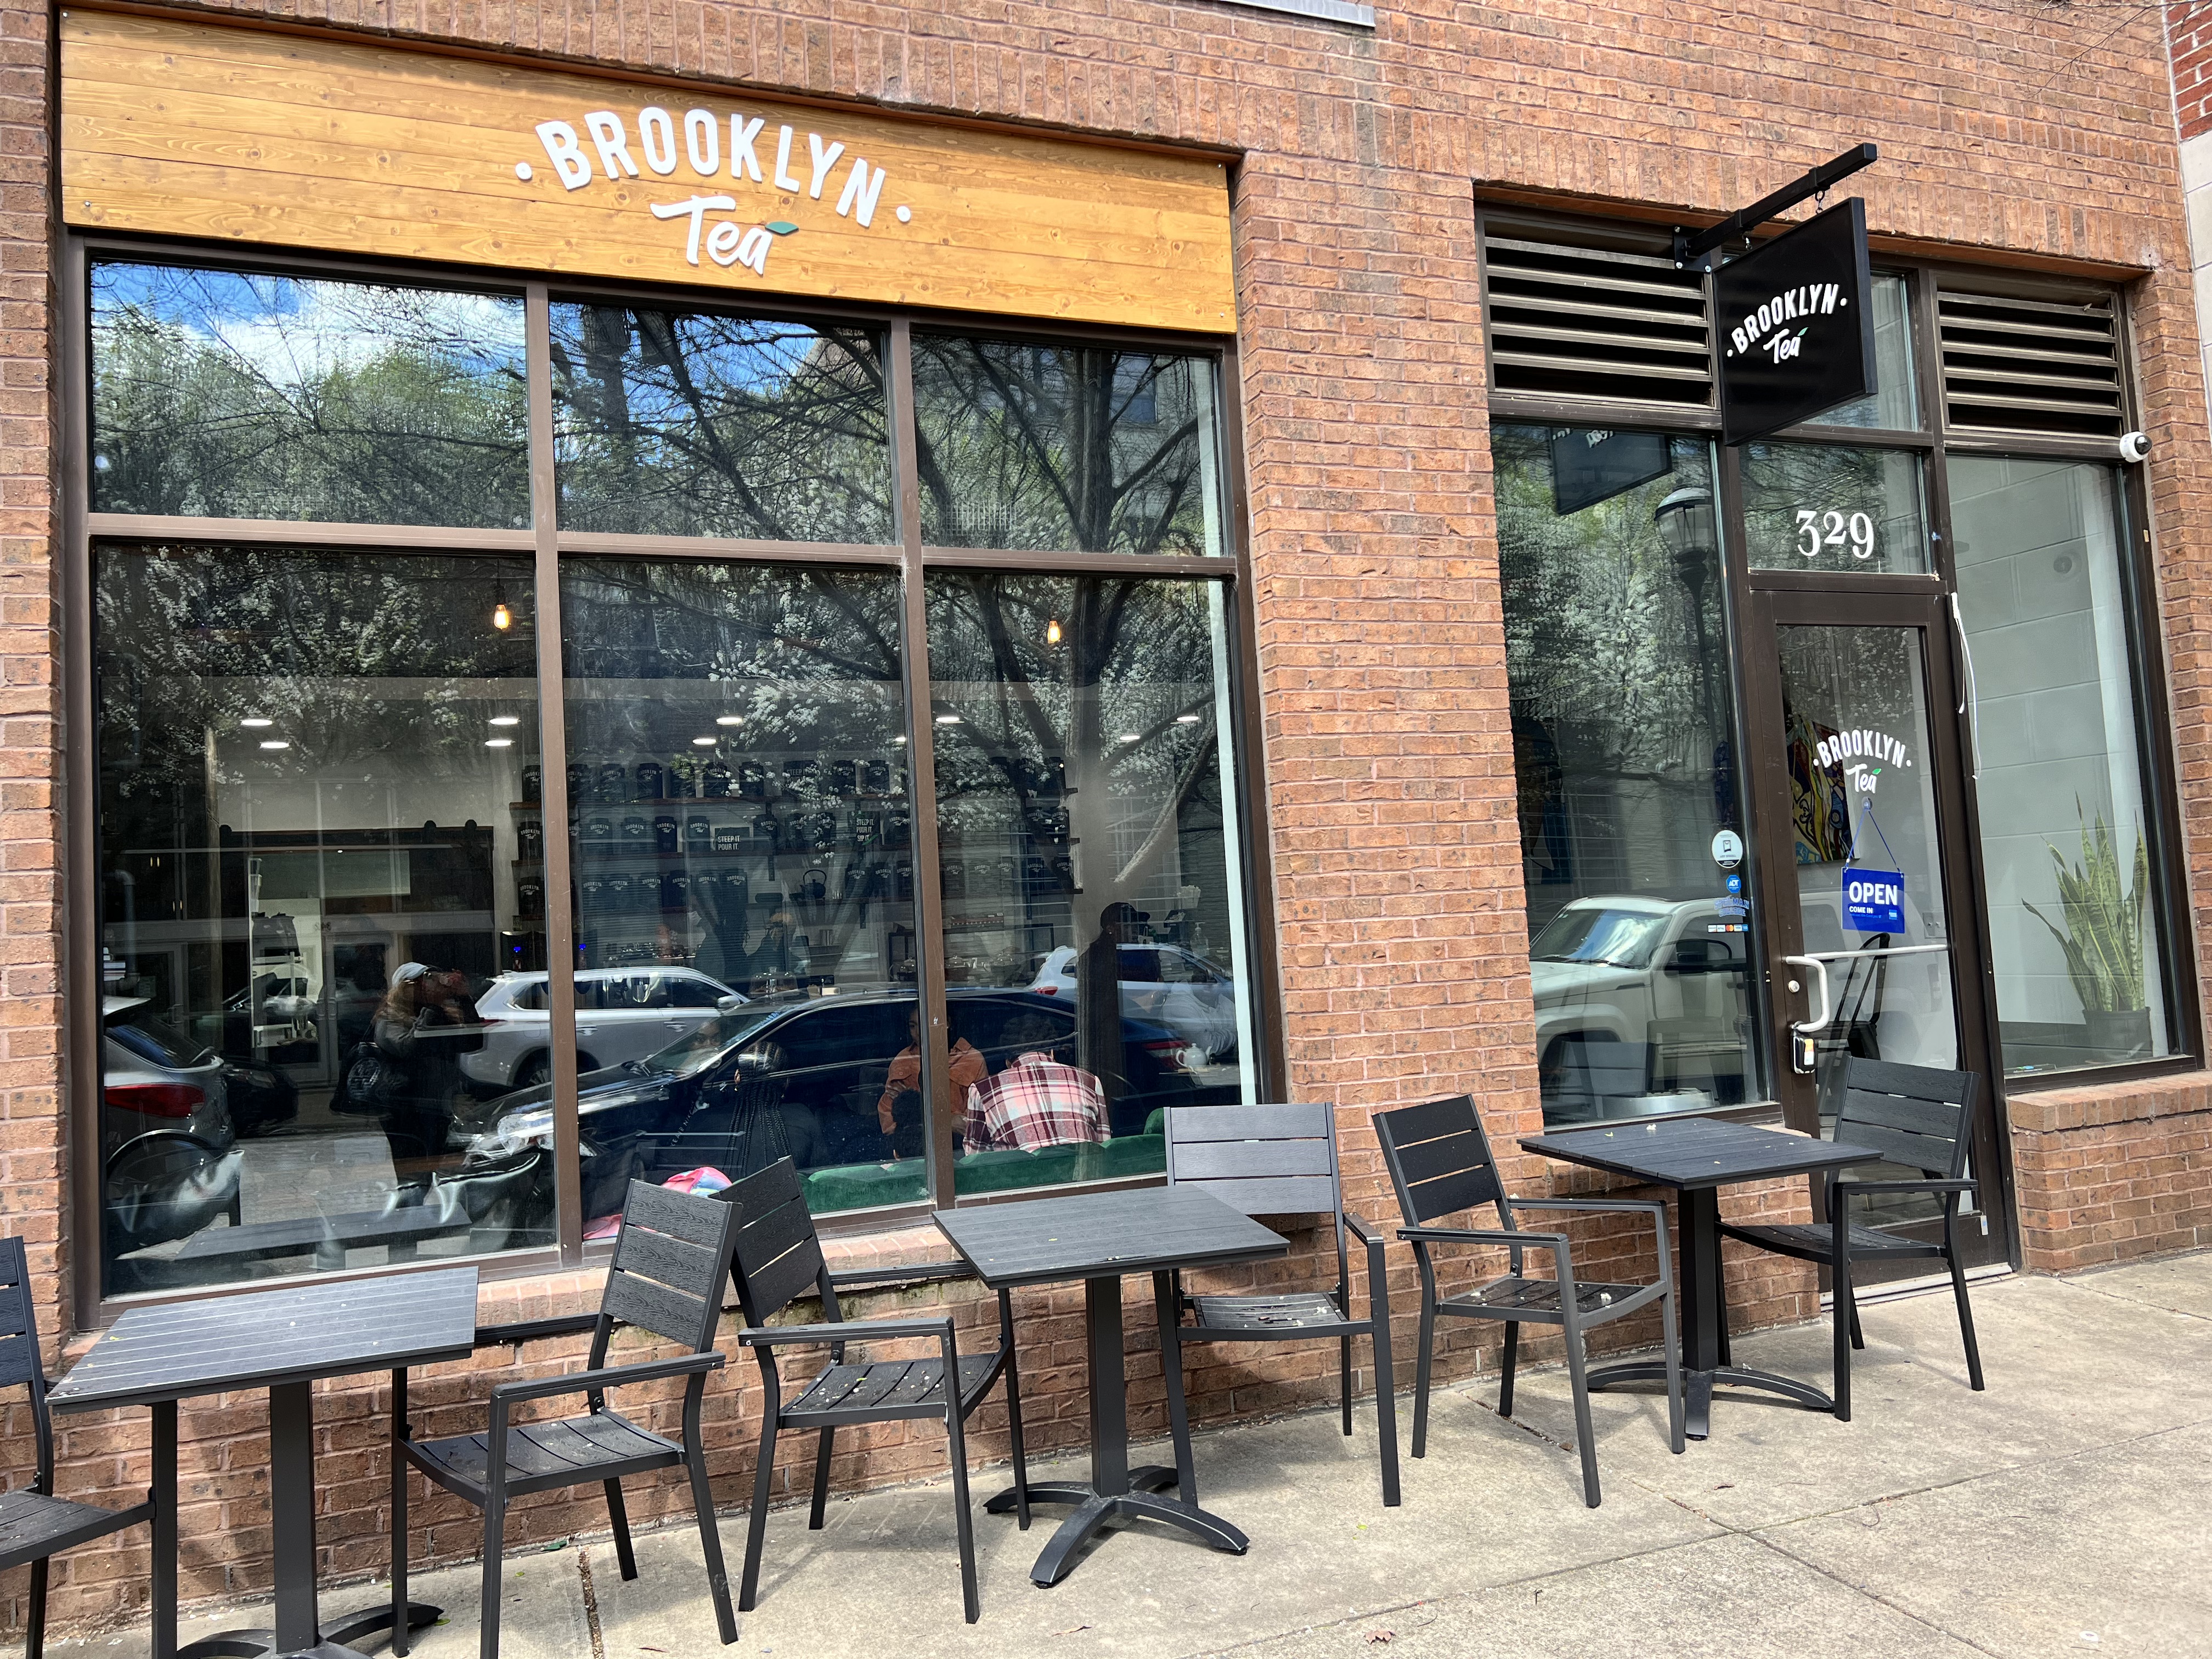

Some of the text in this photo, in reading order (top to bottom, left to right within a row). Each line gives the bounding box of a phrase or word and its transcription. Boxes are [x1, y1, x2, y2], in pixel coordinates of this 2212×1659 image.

[535, 106, 886, 228] BROOKLYN
[650, 194, 774, 275] Tea
[1731, 283, 1839, 354] BROOKLYN
[1763, 328, 1801, 364] Tea
[1795, 510, 1875, 559] 329
[1816, 729, 1906, 769] BROOKLYN
[1845, 763, 1877, 794] Tea
[1849, 881, 1898, 905] OPEN
